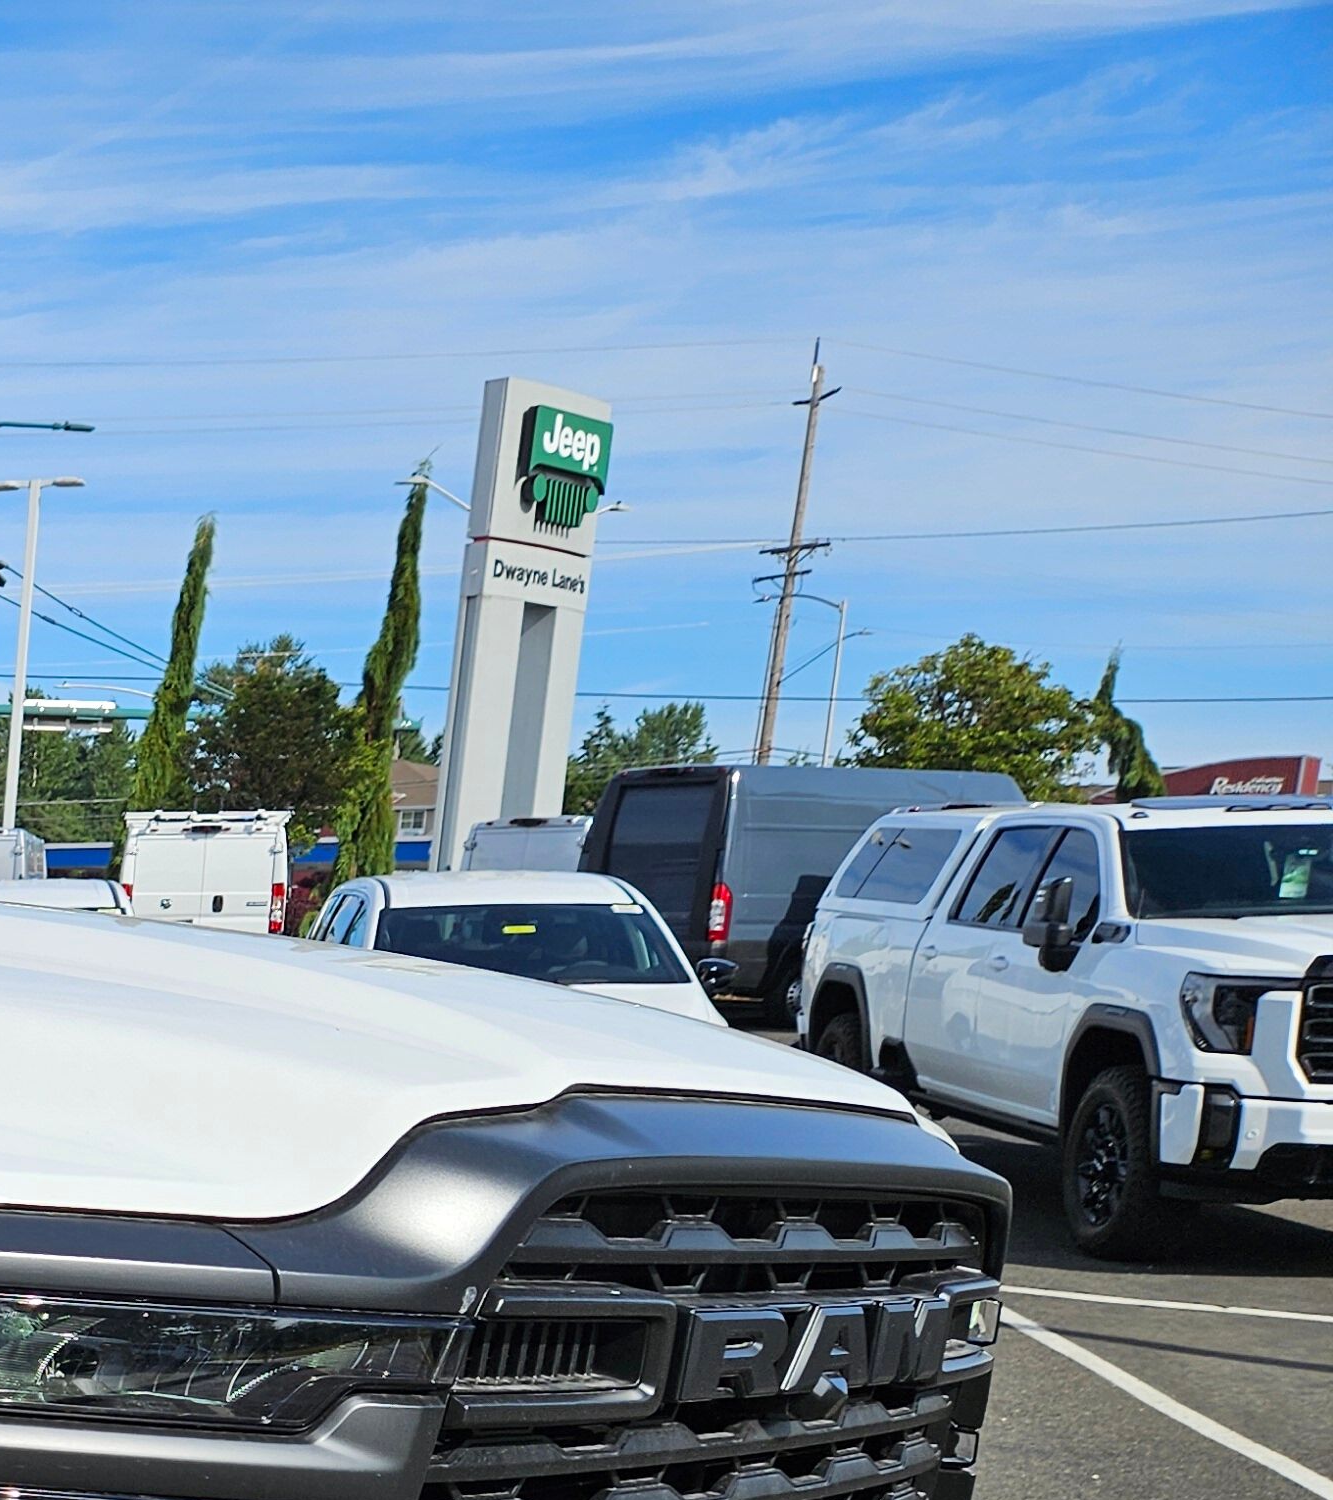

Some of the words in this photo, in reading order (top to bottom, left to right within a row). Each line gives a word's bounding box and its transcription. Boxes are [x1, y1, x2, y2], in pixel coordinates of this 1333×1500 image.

[543, 413, 601, 471] Jeep
[493, 559, 548, 588] Dwayne
[551, 568, 586, 595] Lane's
[680, 1298, 950, 1402] RAM
